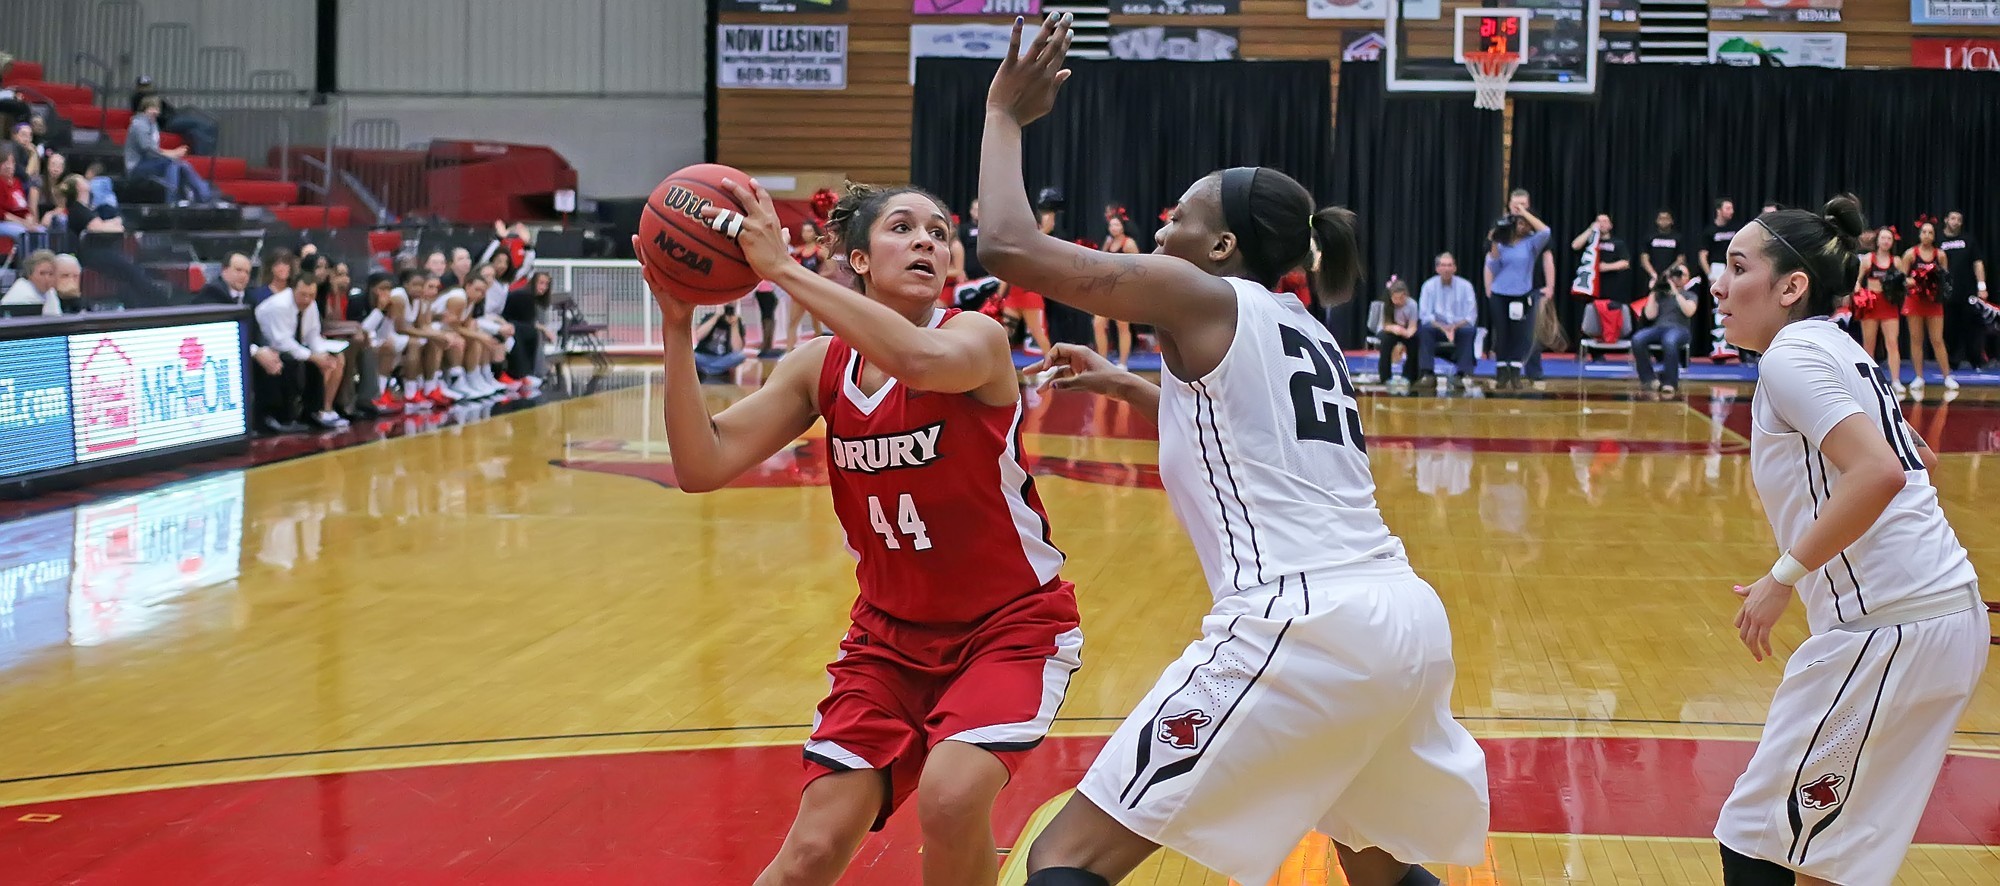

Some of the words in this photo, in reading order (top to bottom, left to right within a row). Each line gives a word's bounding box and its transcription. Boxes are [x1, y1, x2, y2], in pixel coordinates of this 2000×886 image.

[725, 29, 763, 51] NOW
[769, 29, 840, 52] LEASING!
[653, 229, 714, 277] NCAA
[832, 420, 946, 474] DRURY
[868, 492, 933, 551] 44
